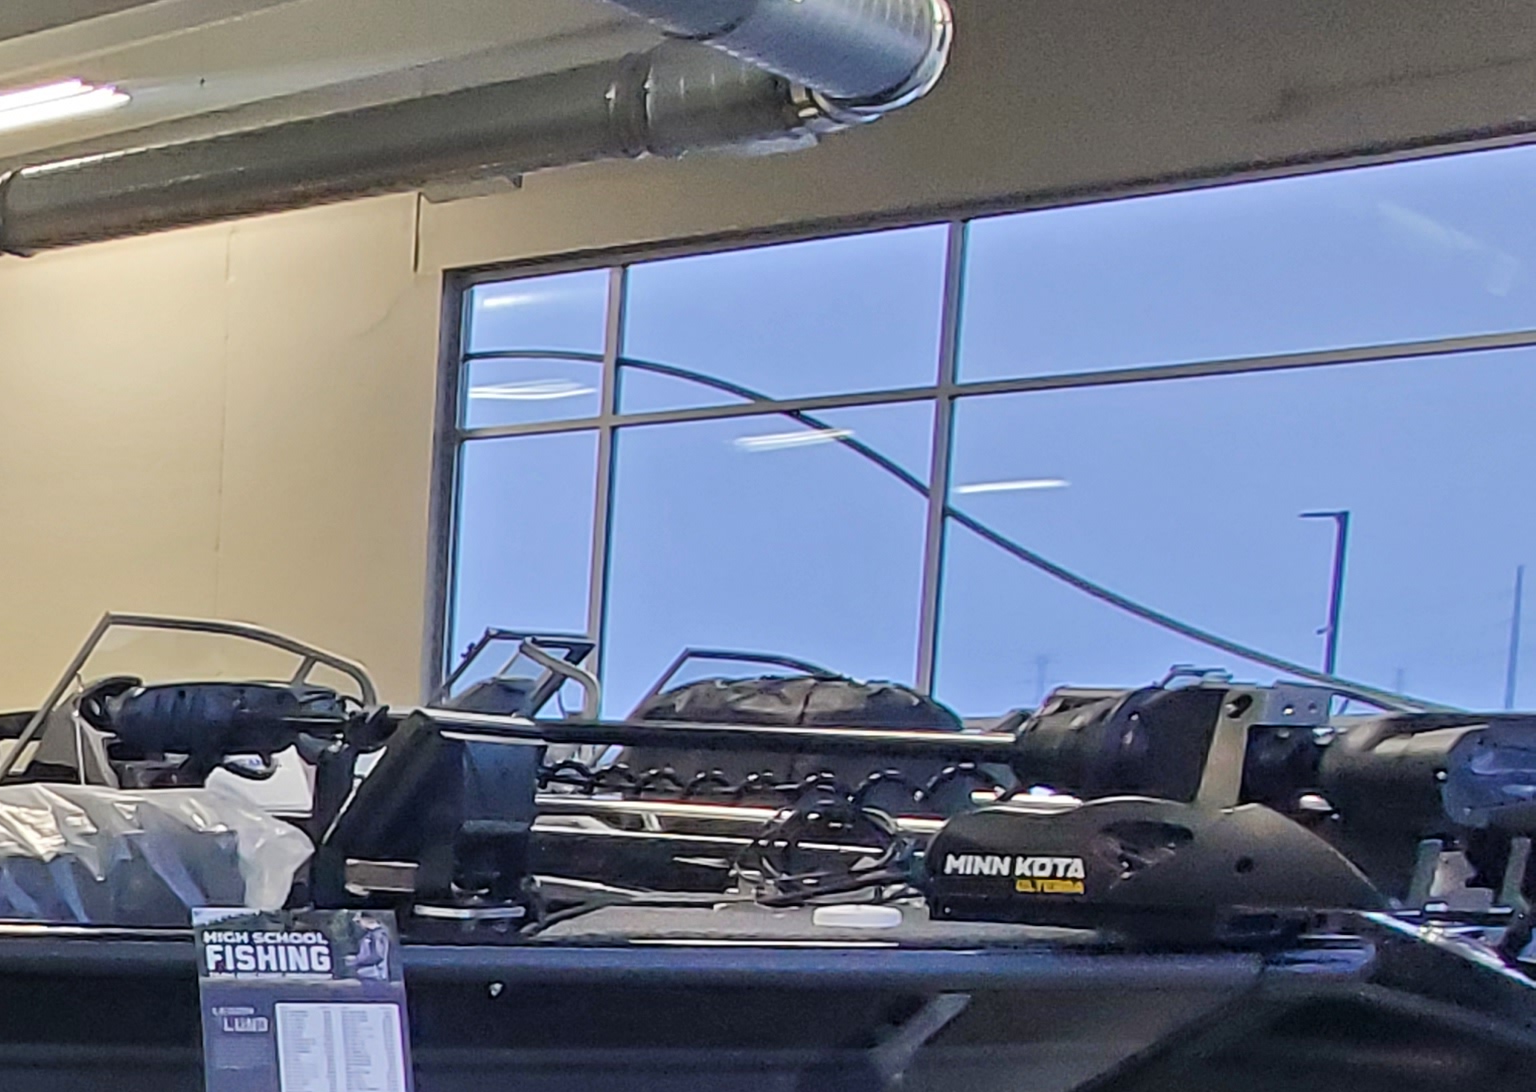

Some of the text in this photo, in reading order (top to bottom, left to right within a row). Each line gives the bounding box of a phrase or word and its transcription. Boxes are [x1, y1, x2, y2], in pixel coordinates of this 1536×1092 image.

[944, 853, 1085, 879] MINN KOTA
[203, 930, 329, 945] HIGH SCHOOL
[206, 944, 332, 972] FISHING
